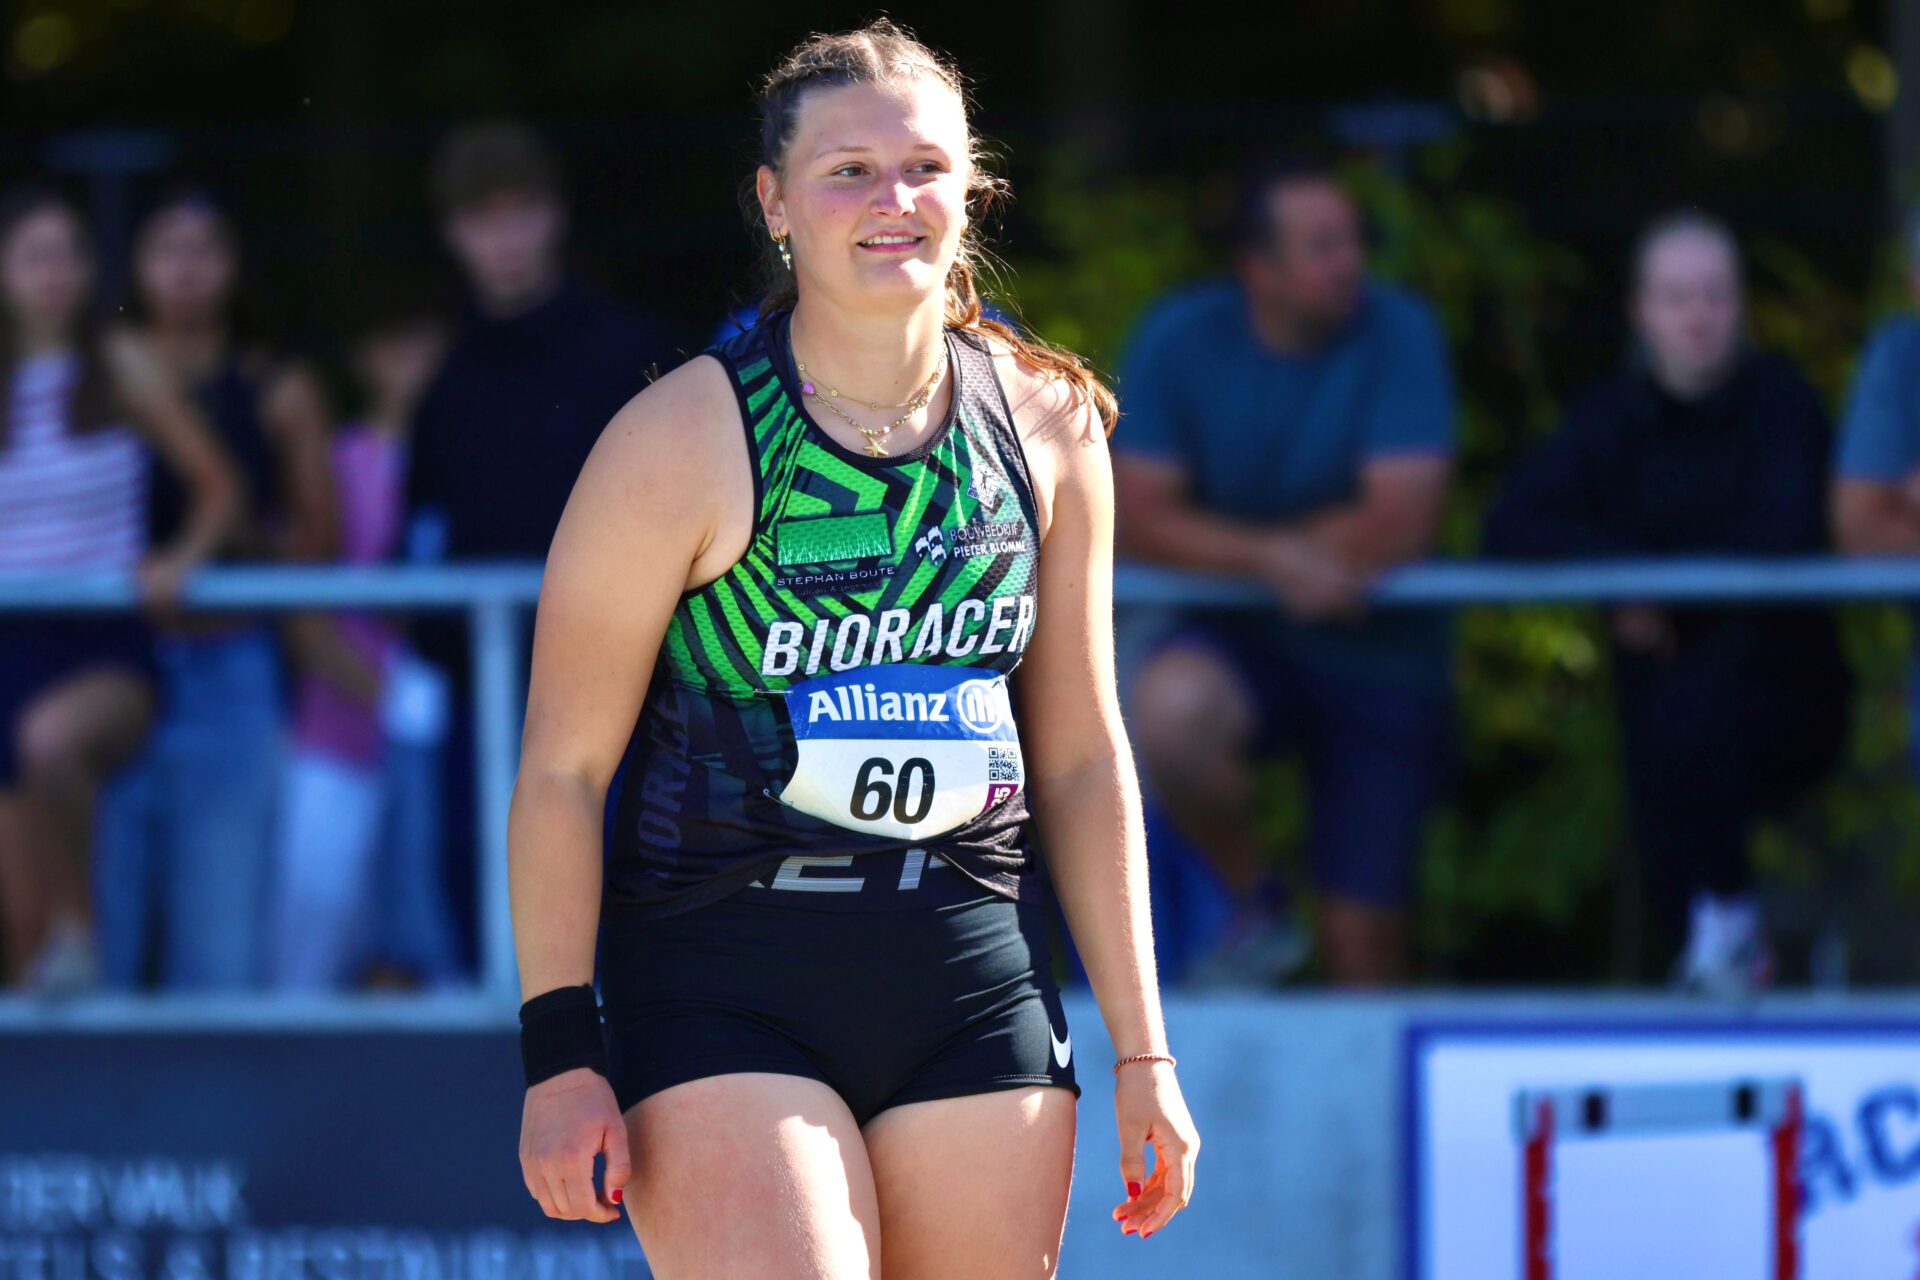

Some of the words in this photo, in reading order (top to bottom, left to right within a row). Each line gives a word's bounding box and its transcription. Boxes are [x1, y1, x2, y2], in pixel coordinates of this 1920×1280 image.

[950, 522, 1019, 541] BOUWBEDRIJF
[953, 543, 989, 558] PIETER
[989, 540, 1026, 554] BLOMME
[777, 572, 844, 586] STEPHAN
[849, 566, 895, 580] BOUTE
[762, 595, 1035, 676] BIORACER
[808, 683, 950, 722] Allianz
[850, 757, 935, 824] 60
